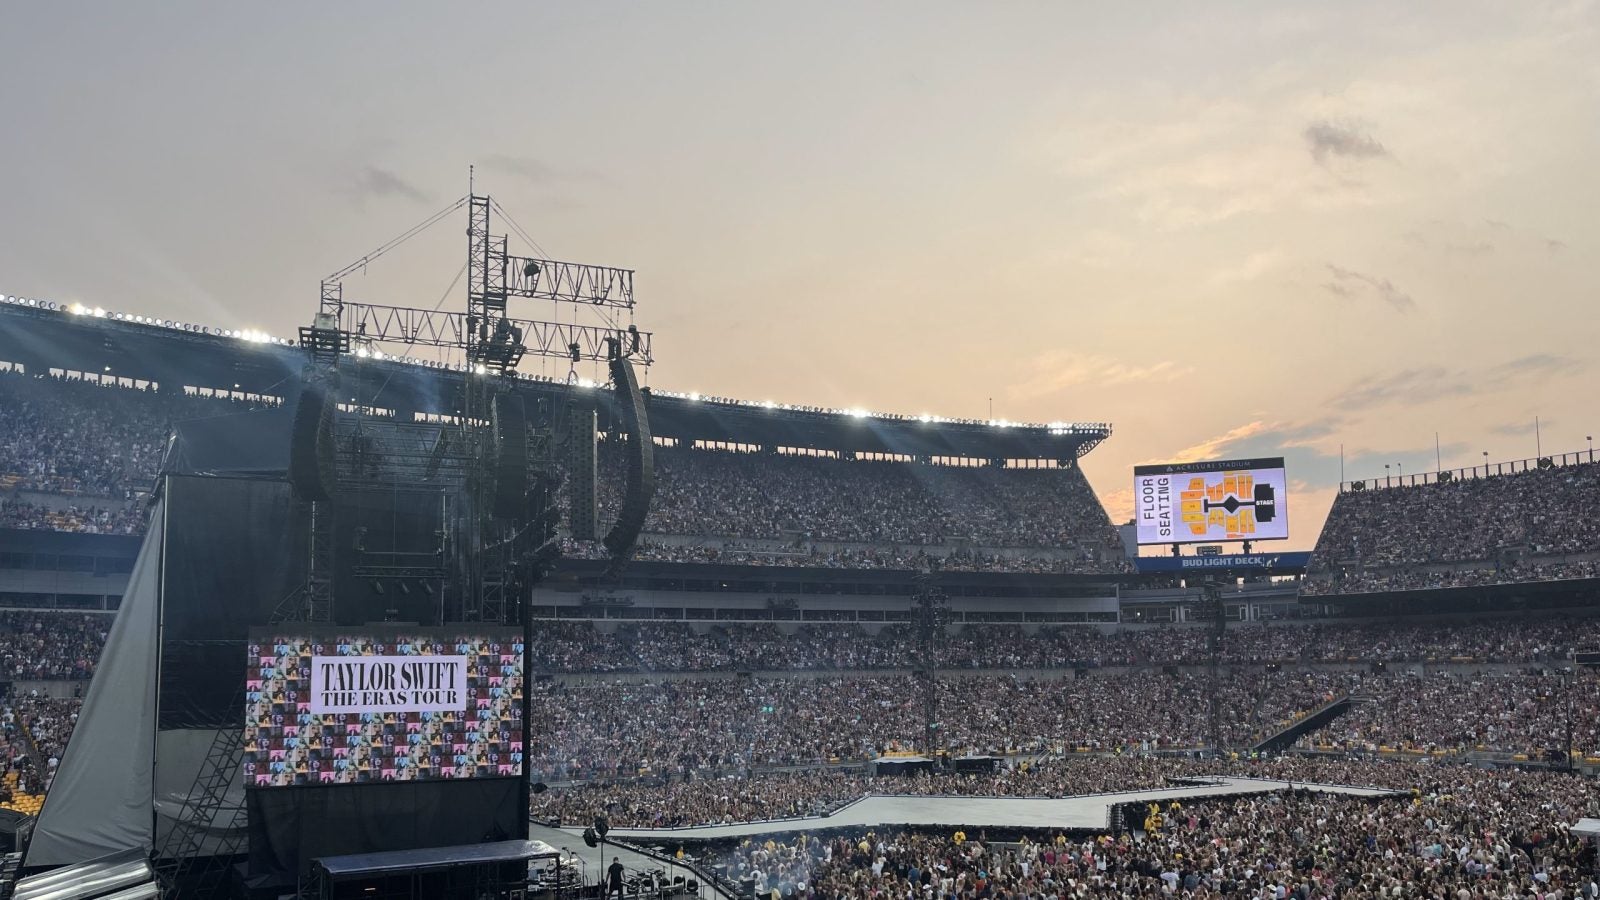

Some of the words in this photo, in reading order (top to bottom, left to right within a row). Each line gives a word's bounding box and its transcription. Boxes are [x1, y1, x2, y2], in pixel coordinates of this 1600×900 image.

[1218, 461, 1250, 469] STADIUM
[1142, 478, 1154, 520] FLOOR
[1157, 477, 1171, 536] SEATING
[1182, 559, 1203, 567] BUD
[1203, 558, 1233, 566] LIGHT
[1234, 557, 1262, 565] DECK
[321, 662, 395, 691] TAYLOR
[400, 661, 459, 690] SWIFT
[320, 692, 358, 706] THE
[362, 691, 407, 705] ERAS
[411, 690, 457, 705] TOUR
